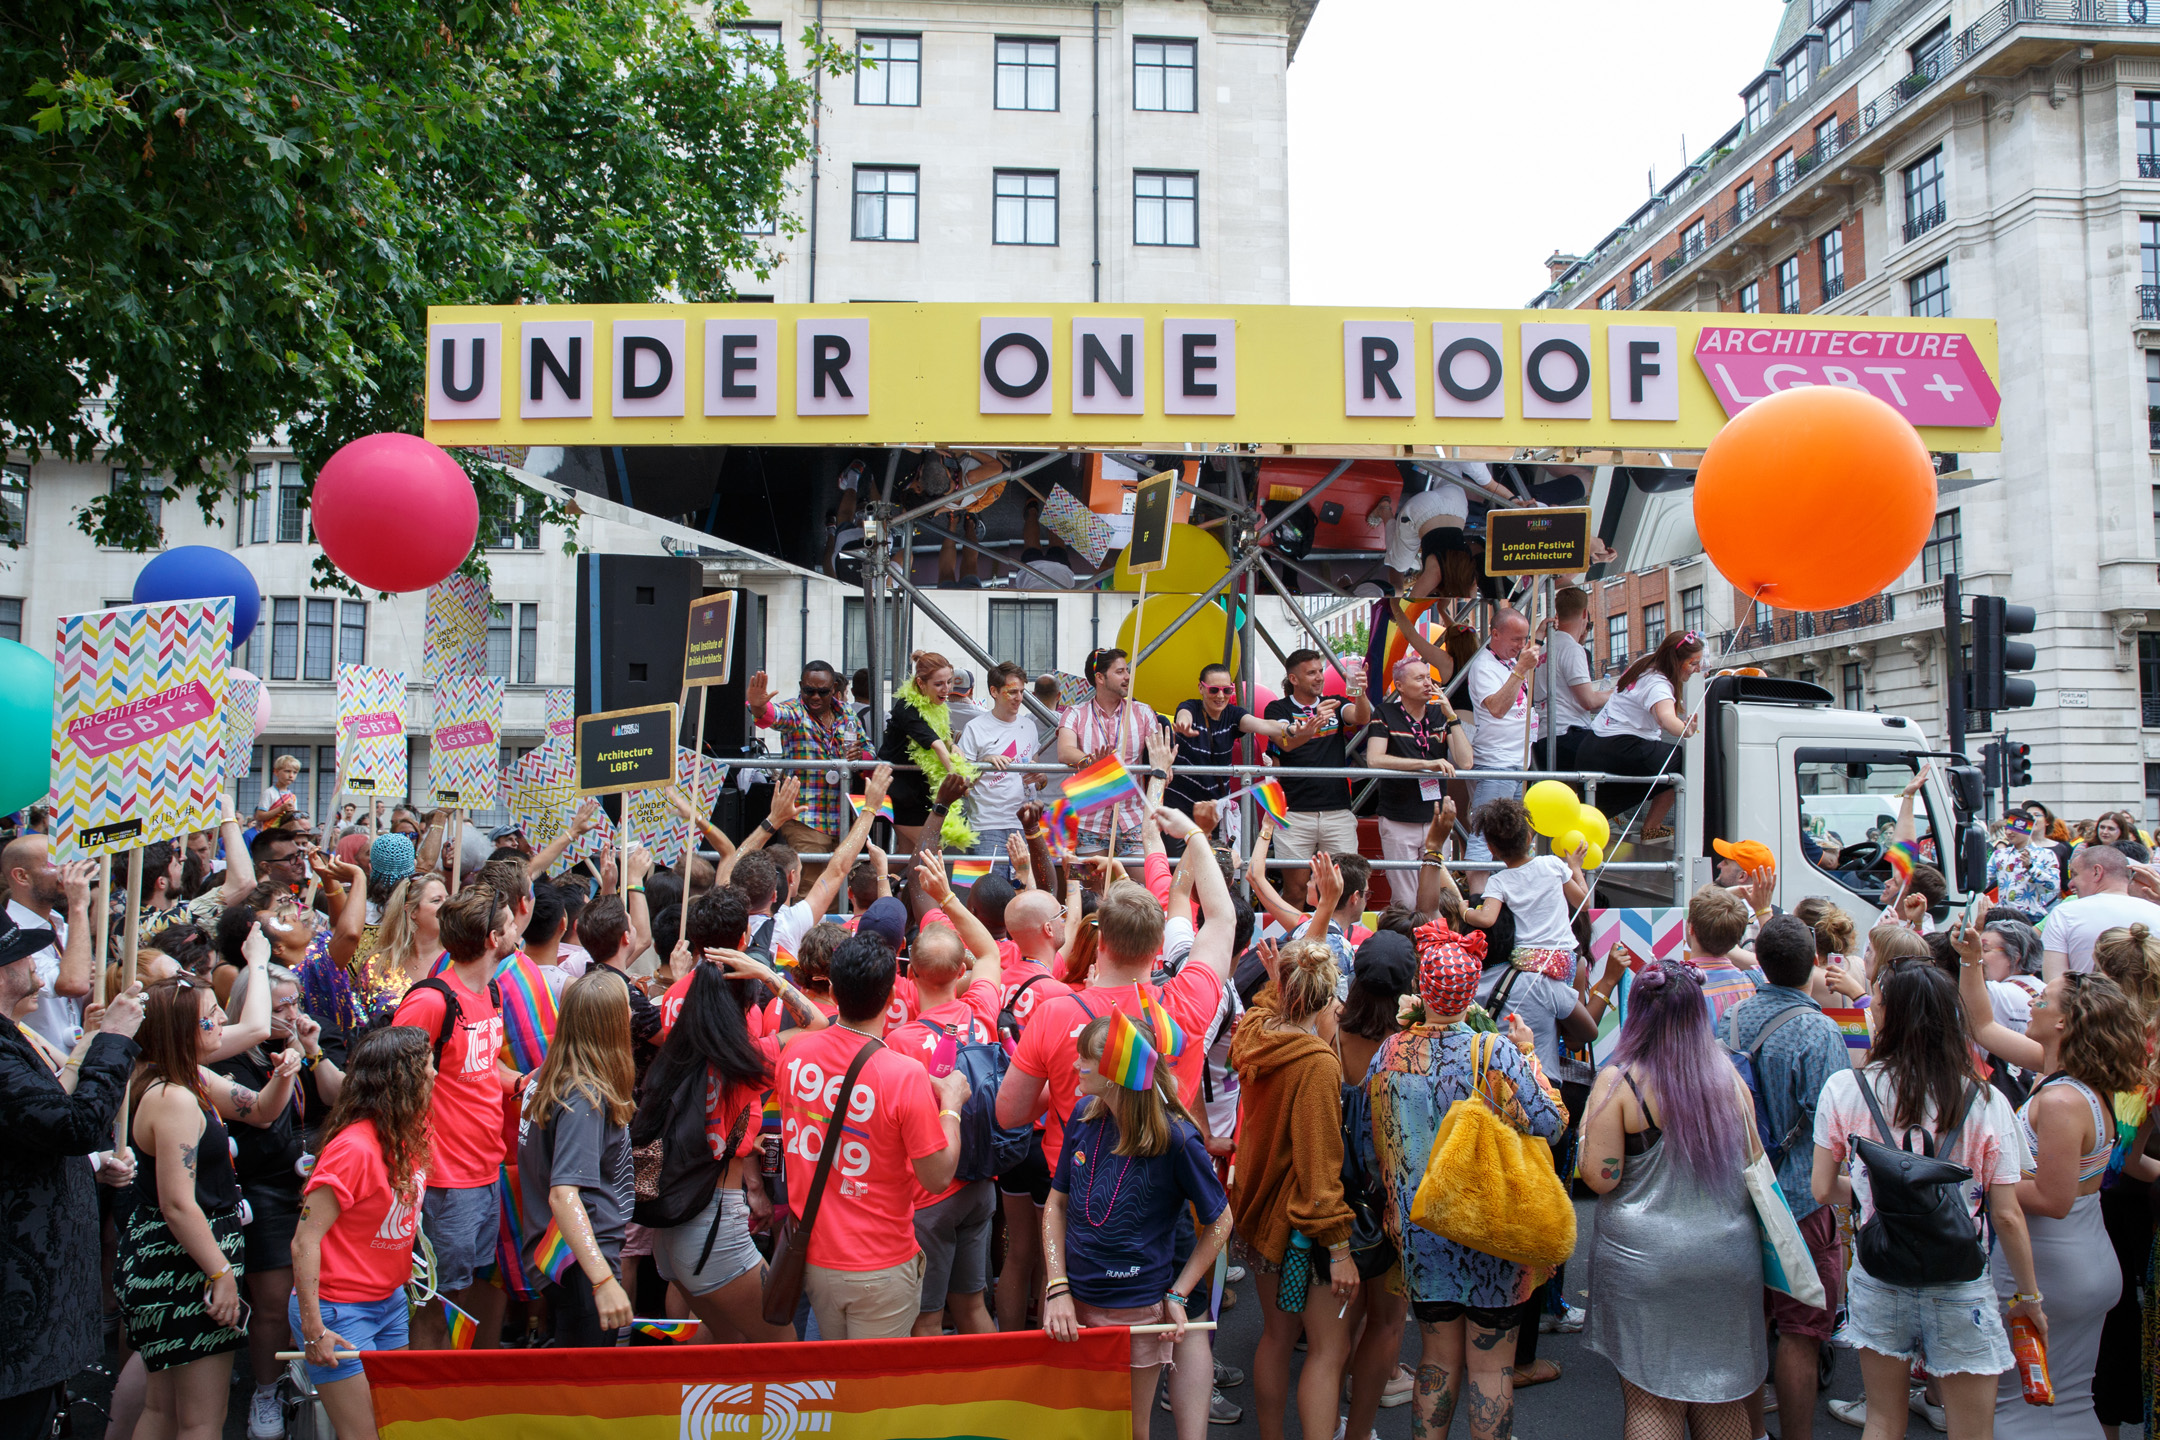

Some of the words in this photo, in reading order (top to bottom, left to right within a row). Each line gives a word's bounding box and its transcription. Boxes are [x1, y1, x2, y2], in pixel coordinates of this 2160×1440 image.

[1701, 329, 1962, 358] ARCHITECTURE
[441, 334, 854, 403] UNDER
[983, 331, 1218, 399] ONE
[1360, 336, 1661, 404] ROOF
[1502, 542, 1536, 551] London
[1538, 540, 1575, 550] Festival
[1503, 552, 1513, 561] of
[1514, 551, 1573, 561] Architecture
[437, 626, 458, 638] UNDER
[436, 636, 451, 645] ONE
[442, 639, 459, 650] ROOF
[690, 642, 701, 654] Royal
[688, 655, 702, 667] British
[701, 652, 723, 665] Architects
[70, 680, 198, 733] ARCHITECTURE
[343, 711, 394, 724] ARCHITECTURE
[78, 701, 200, 751] LGBT+
[436, 720, 486, 736] ARCHITECTURE
[621, 728, 640, 736] LONDON
[438, 730, 487, 748] LGBT+
[597, 747, 653, 762] Architecture
[610, 761, 639, 773] LGBT+
[637, 809, 654, 817] ONE
[640, 801, 666, 810] UNDER
[151, 809, 182, 826] RIBA
[535, 809, 552, 834] UNDER
[641, 815, 664, 823] ROOF
[540, 823, 552, 840] ONE
[546, 819, 561, 841] ROOF
[81, 831, 106, 848] LFA
[787, 1057, 876, 1123] 1969
[1130, 1265, 1141, 1273] EF
